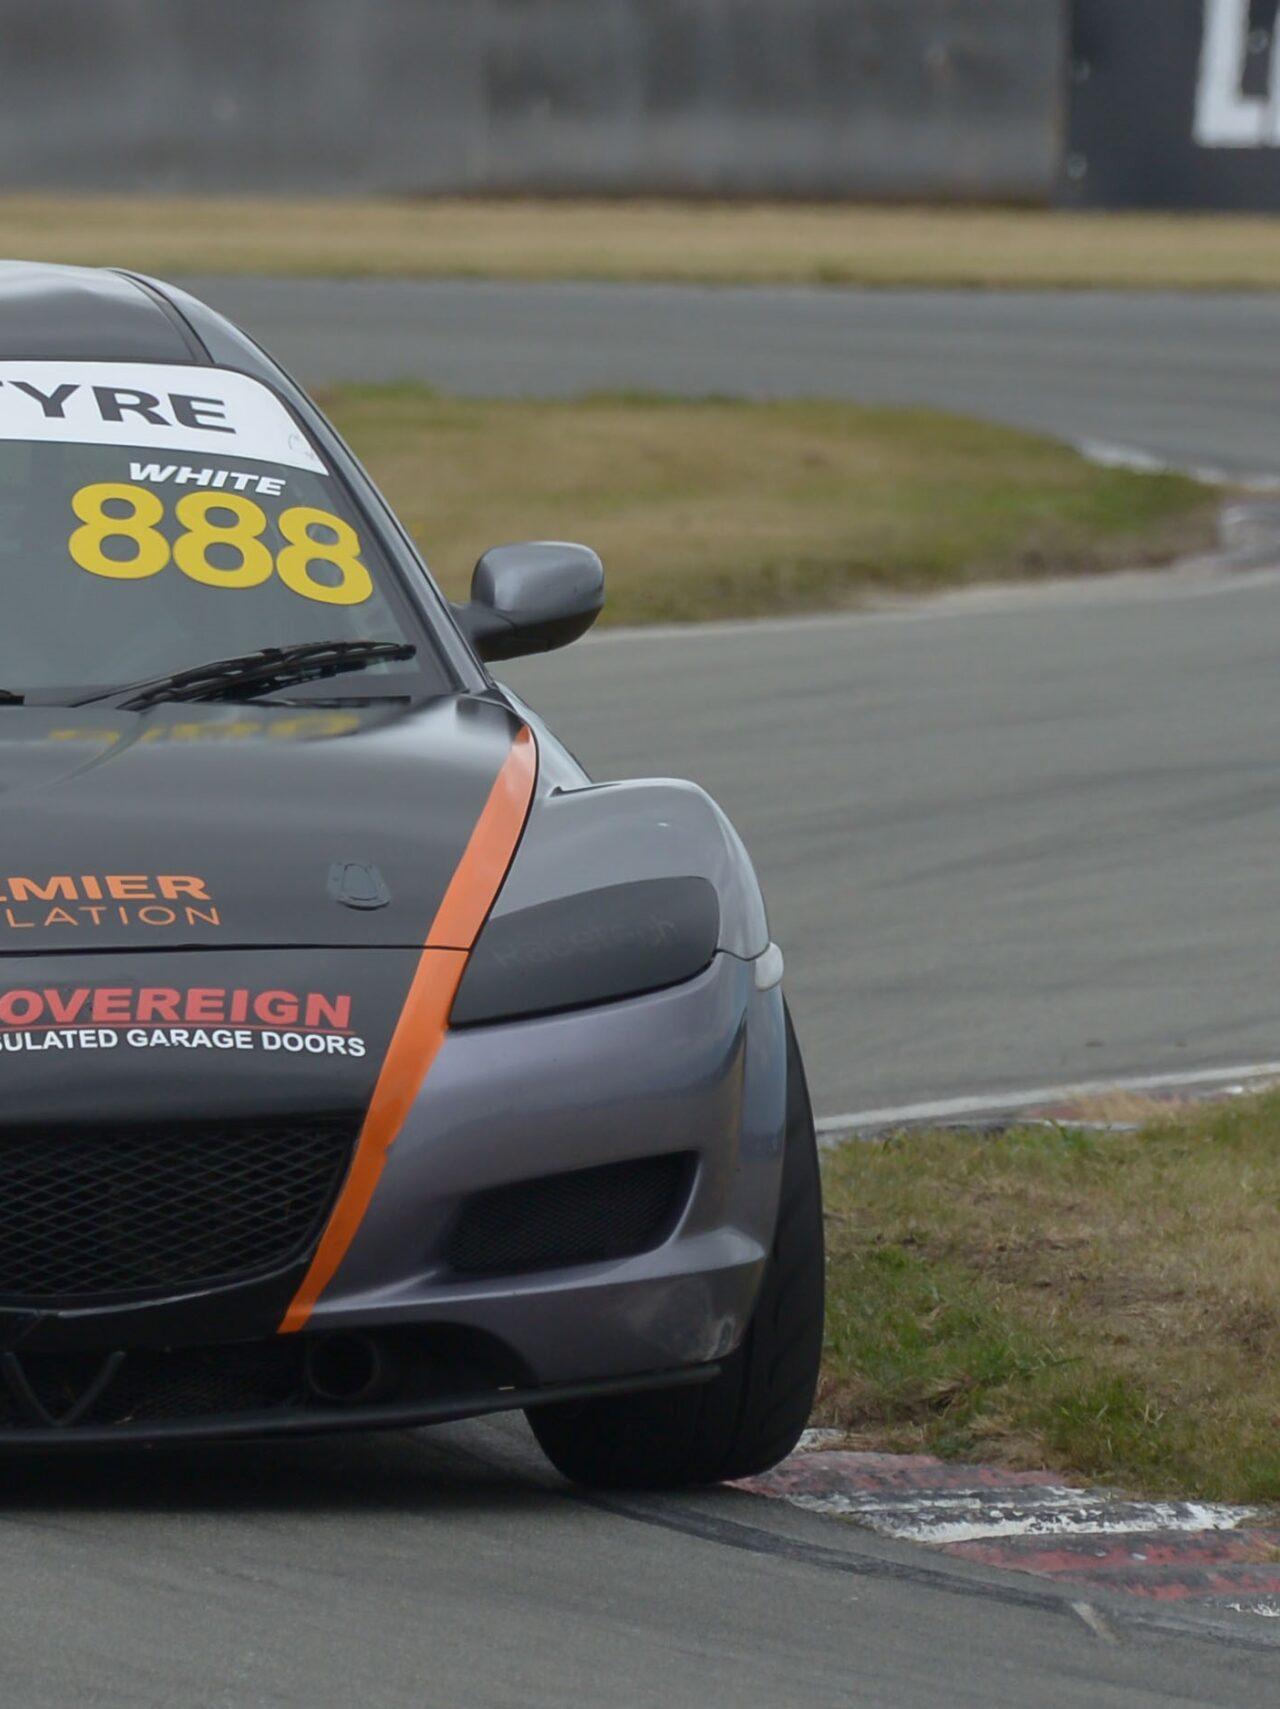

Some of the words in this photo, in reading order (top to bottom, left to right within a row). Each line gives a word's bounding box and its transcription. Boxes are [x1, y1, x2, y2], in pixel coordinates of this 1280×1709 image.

[129, 462, 286, 496] WHITE
[68, 482, 374, 605] 888
[126, 1029, 253, 1049] GARAGE
[261, 1030, 366, 1057] DOORS
